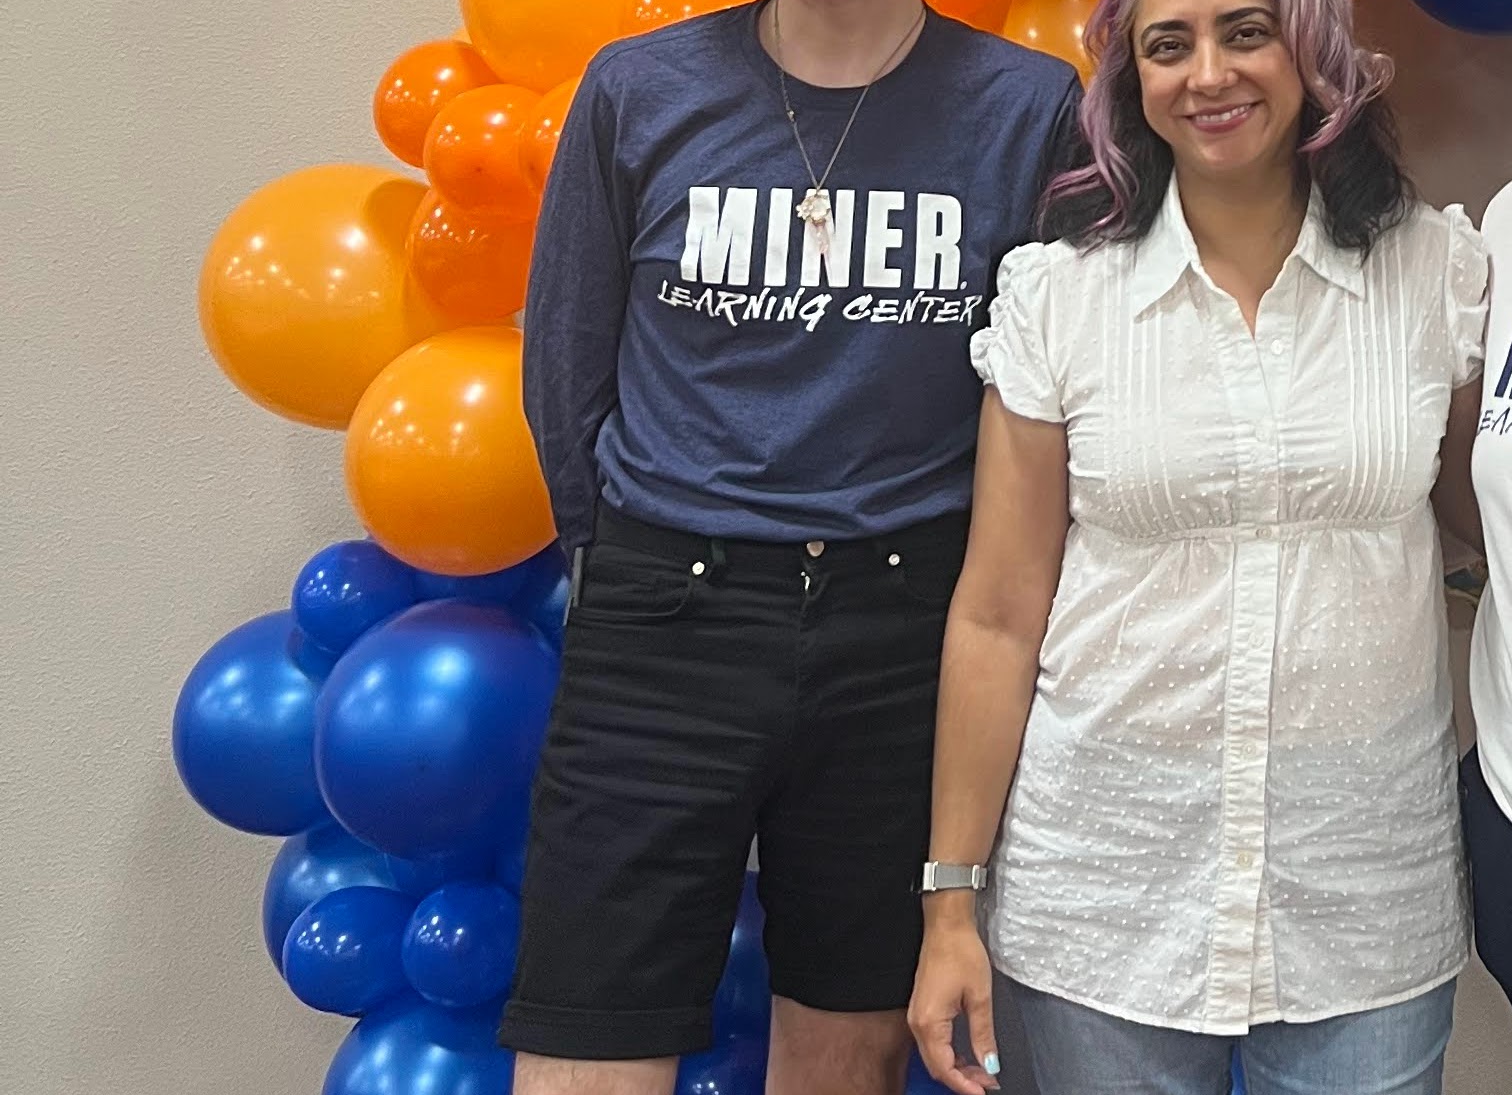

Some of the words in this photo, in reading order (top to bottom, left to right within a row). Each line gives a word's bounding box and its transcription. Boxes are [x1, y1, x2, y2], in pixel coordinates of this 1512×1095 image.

[680, 186, 963, 290] MINER
[657, 280, 833, 331] LEARNING
[843, 290, 982, 326] CENTER
